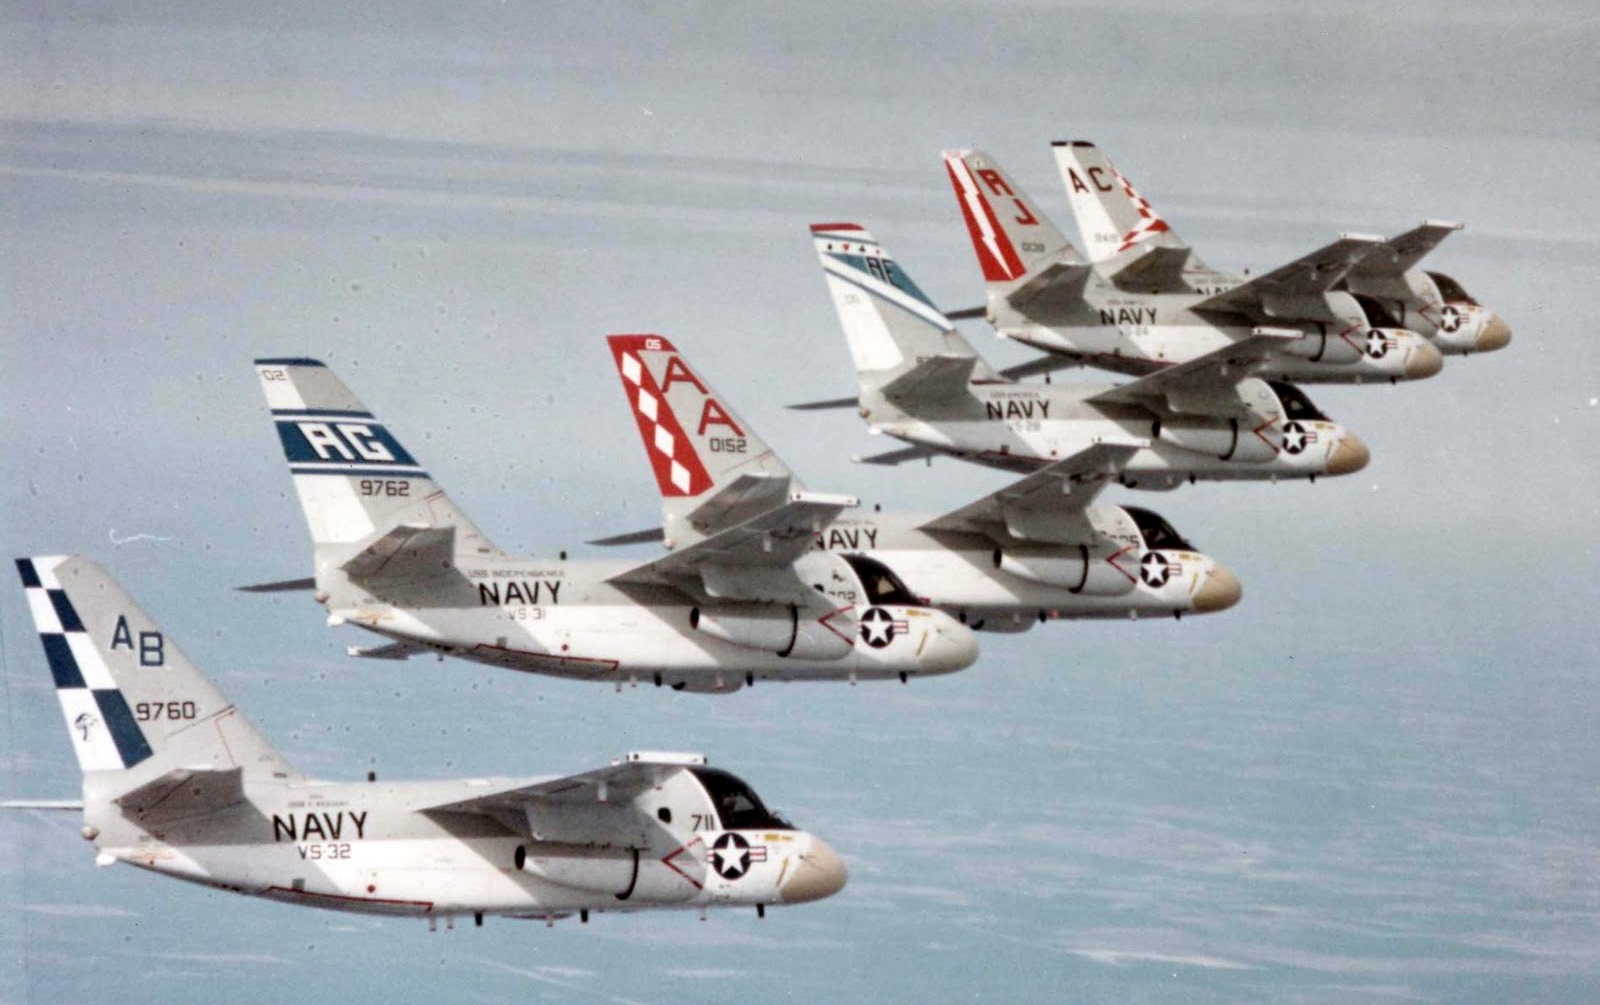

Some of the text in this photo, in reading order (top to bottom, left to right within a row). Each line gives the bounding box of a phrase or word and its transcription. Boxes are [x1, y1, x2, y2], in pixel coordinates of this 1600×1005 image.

[1068, 167, 1112, 193] AC
[1100, 308, 1157, 325] NAVY
[986, 400, 1049, 419] NAVY
[709, 438, 747, 452] 0152
[360, 480, 410, 496] 9762
[479, 581, 561, 605] NAVY
[111, 615, 164, 667] AB
[136, 701, 196, 721] 9760
[272, 811, 367, 842] NAVY
[691, 814, 714, 831] 711
